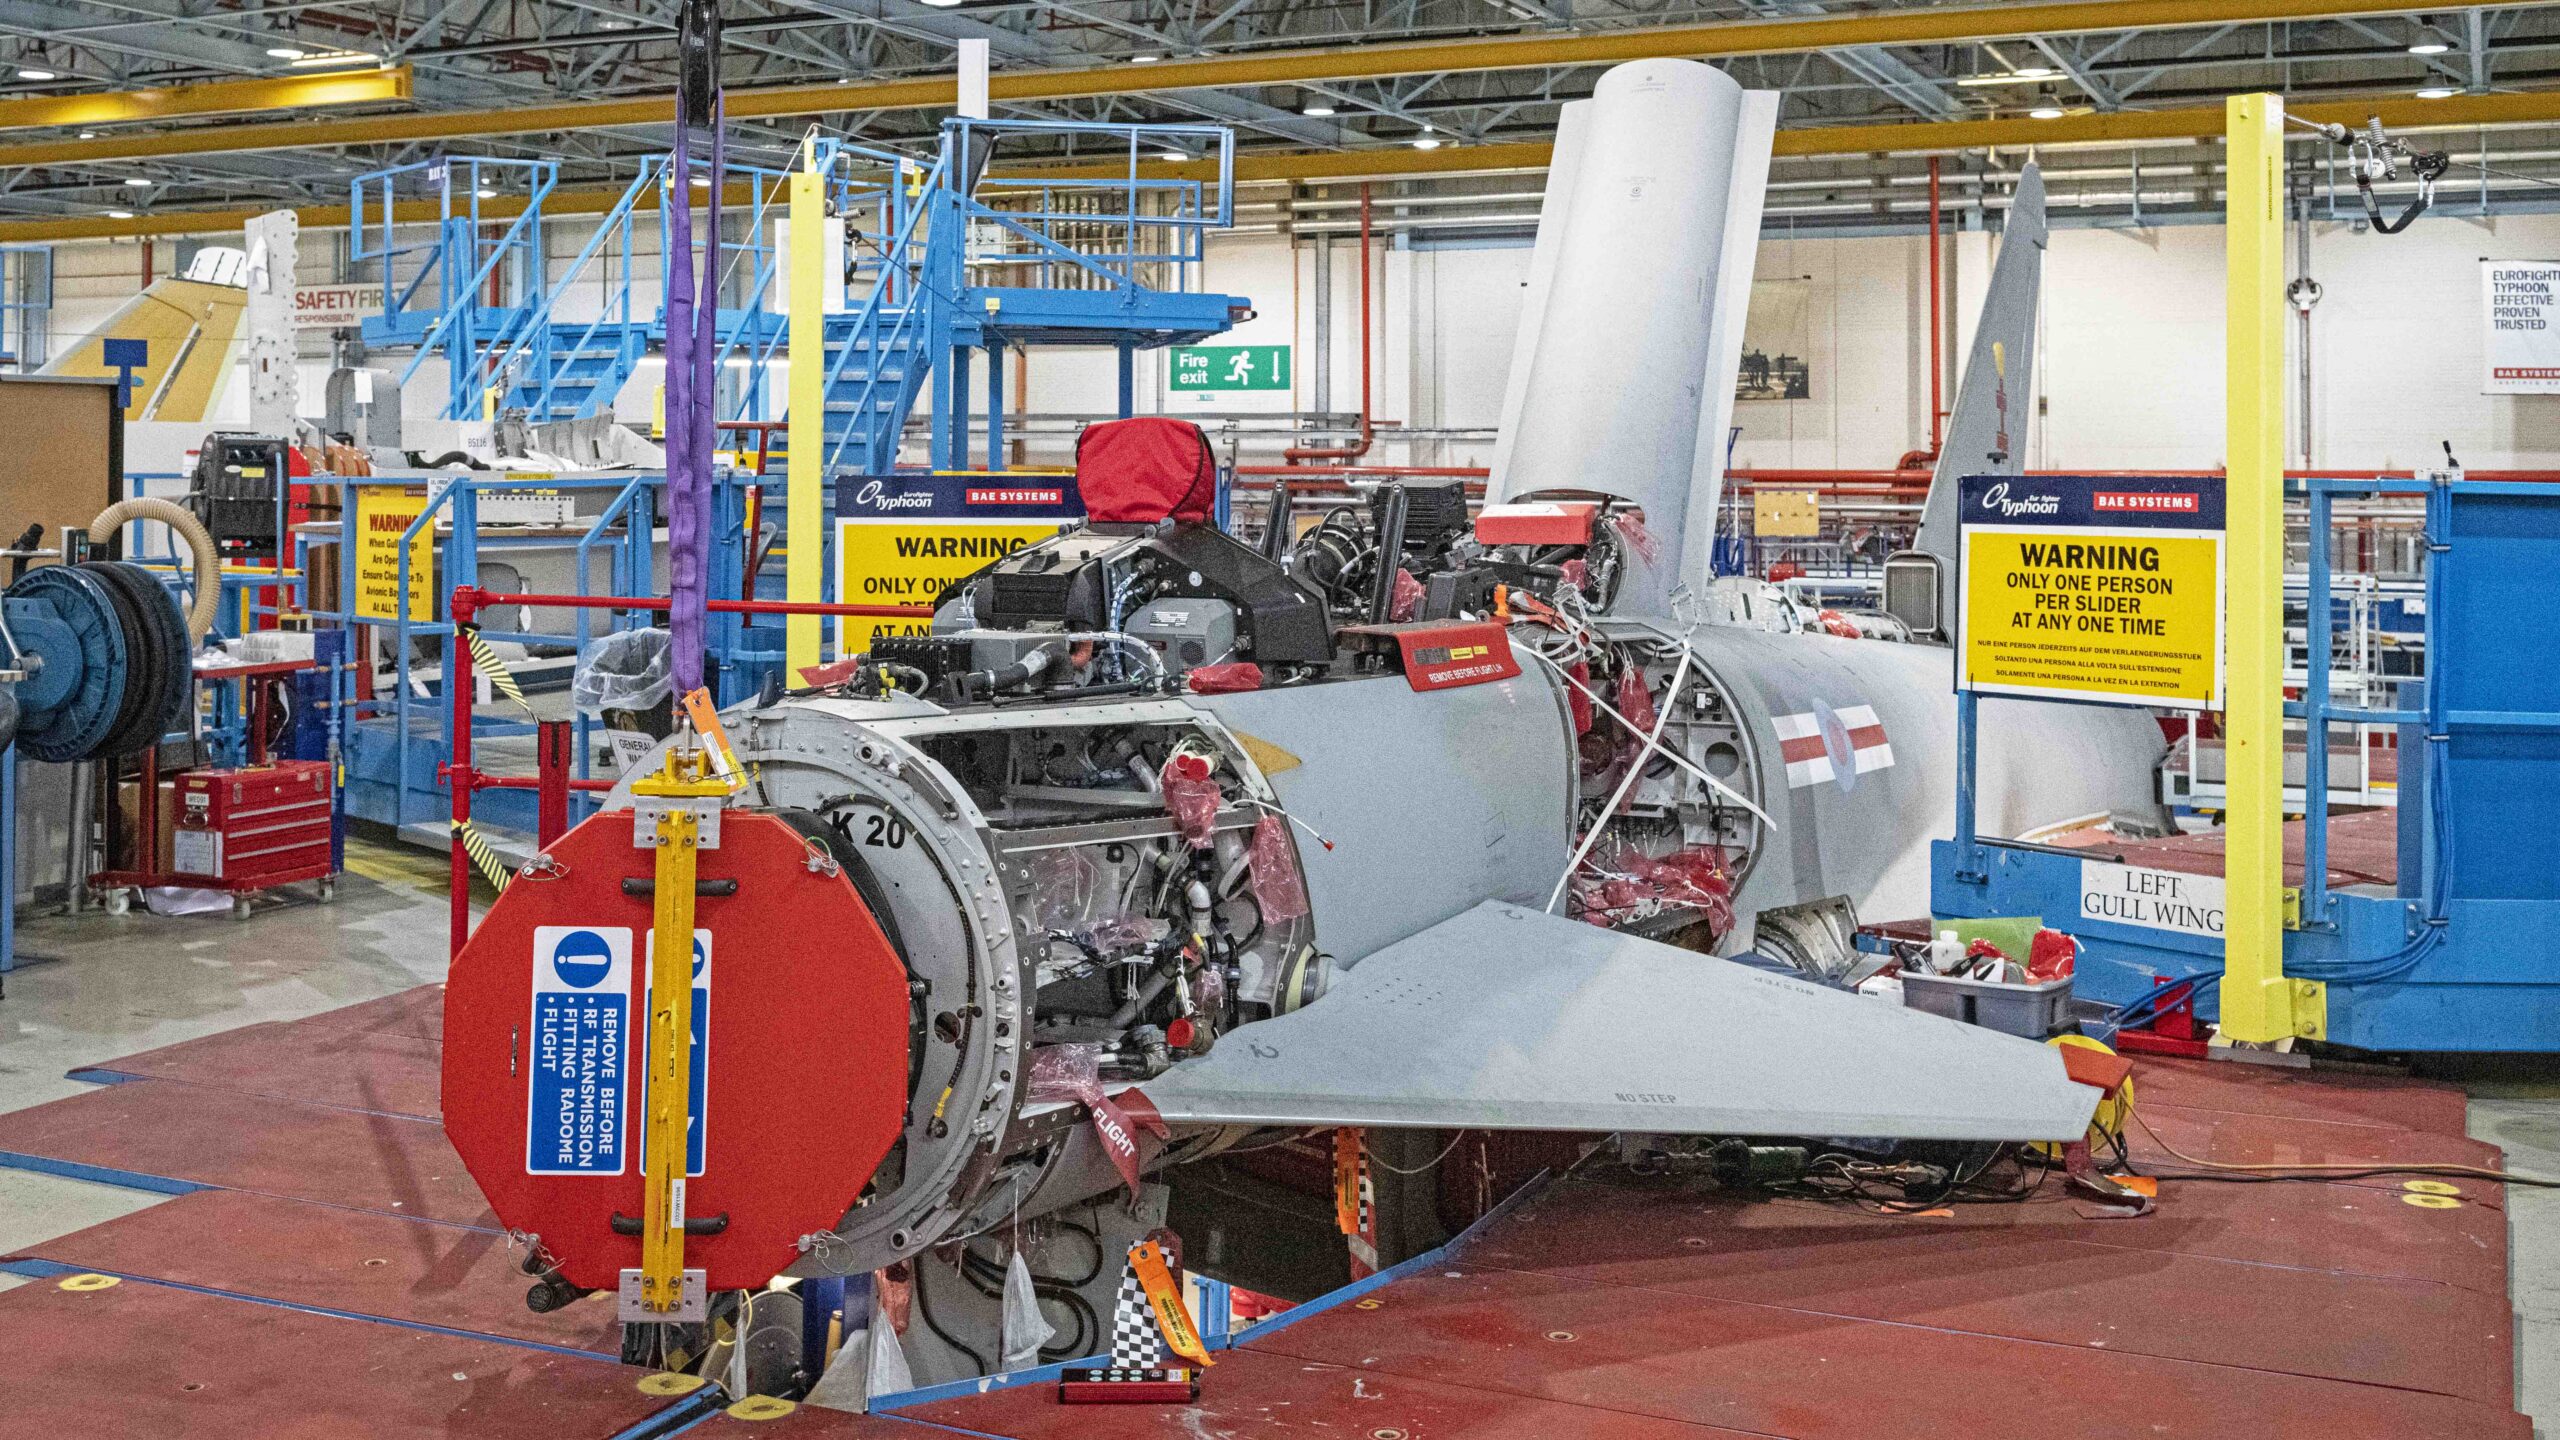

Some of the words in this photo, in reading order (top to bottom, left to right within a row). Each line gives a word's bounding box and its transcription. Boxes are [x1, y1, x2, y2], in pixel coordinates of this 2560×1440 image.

[2494, 282, 2549, 293] TYPHOON
[295, 290, 356, 310] SAFETY
[2493, 294, 2554, 306] EFFECTIVE
[2494, 306, 2540, 318] PROVEN
[2494, 319, 2546, 330] TRUSTED
[1180, 353, 1209, 368] Fire
[1180, 370, 1209, 384] exit
[875, 494, 932, 510] Typhoon
[971, 492, 996, 501] BAE
[1000, 492, 1058, 501] SYSTEMS
[2098, 496, 2125, 507] BAE
[2129, 496, 2192, 508] SYSTEMS
[2001, 499, 2059, 516] Typhoon
[369, 538, 385, 548] When
[373, 554, 382, 564] Are
[2019, 543, 2159, 571] WARNING
[363, 570, 383, 580] Ensure
[416, 573, 424, 583] To
[2006, 572, 2050, 589] ONLY
[2055, 573, 2091, 591] ONE
[2097, 575, 2173, 595] PERSON
[366, 586, 388, 597] Avionic
[864, 577, 917, 594] ONLY
[923, 577, 964, 594] ON
[380, 603, 392, 613] ALL
[2035, 593, 2069, 610] PER
[2075, 594, 2141, 614] SLIDER
[872, 624, 896, 637] AT
[2011, 612, 2032, 628] AT
[2037, 614, 2072, 631] ANY
[2077, 615, 2113, 633] ONE
[2119, 617, 2166, 636] TIME
[1993, 640, 2008, 648] EINE
[2009, 642, 2036, 650] PERSON
[2038, 644, 2078, 653] JEDERZEITS
[2079, 646, 2093, 654] AUF
[2094, 646, 2111, 655] DEM
[1994, 655, 2027, 663] SOLTANTO
[2044, 658, 2076, 667] PERSONA
[2078, 660, 2095, 668] ALLA
[2096, 661, 2117, 670] VOLTA
[1428, 670, 1455, 683] REMOVE
[1453, 667, 1477, 679] BEFORE
[1996, 669, 2035, 678] SOLAMENTE
[2053, 673, 2085, 682] PERSONA
[2093, 675, 2102, 683] LA
[2104, 676, 2117, 684] VEZ
[2118, 677, 2128, 685] EN
[2130, 678, 2139, 686] LA
[2140, 679, 2180, 689] EXTENTION
[865, 815, 906, 849] 20
[2125, 871, 2182, 899] LEFT
[2084, 892, 2147, 921] GULL
[2153, 901, 2224, 932] WING
[583, 1008, 597, 1029] RF
[542, 1008, 557, 1071] FLIGHT
[561, 1008, 577, 1079] FITTING
[602, 1007, 617, 1078] REMOVE
[579, 1035, 597, 1167] TRANSMISSION
[1614, 1092, 1636, 1102] NO
[1638, 1093, 1676, 1104] STEP
[558, 1088, 575, 1164] RADOME
[599, 1087, 615, 1155] BEFORE
[1093, 1106, 1135, 1157] FLIGHT
